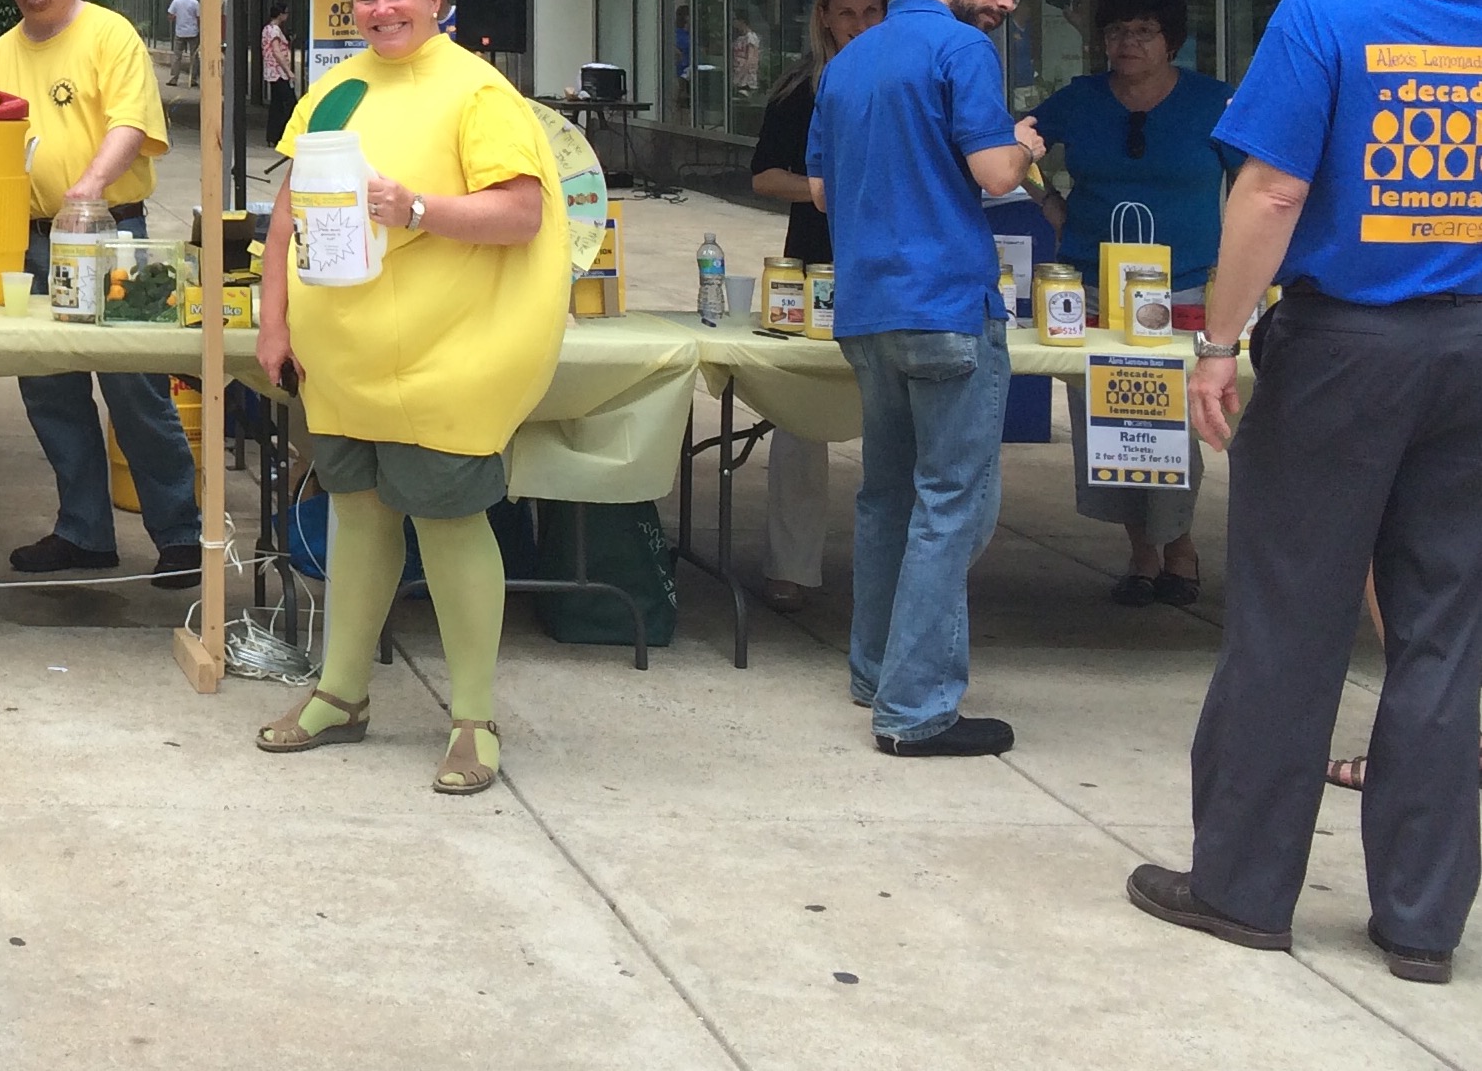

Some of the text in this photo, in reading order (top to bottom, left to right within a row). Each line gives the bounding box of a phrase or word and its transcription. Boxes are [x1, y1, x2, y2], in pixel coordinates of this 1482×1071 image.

[315, 54, 340, 65] Spin
[1376, 48, 1482, 69] Alex's Lemonad
[1379, 79, 1482, 102] a decad
[1371, 185, 1482, 208] lemona
[1116, 369, 1155, 379] decade
[1109, 405, 1167, 416] lemonade!
[1120, 431, 1157, 443] Raffle
[1123, 445, 1154, 454] Tickets:
[1117, 453, 1129, 462] $5
[1140, 454, 1146, 462] 5
[1149, 454, 1162, 462] for
[1164, 455, 1182, 464] $10
